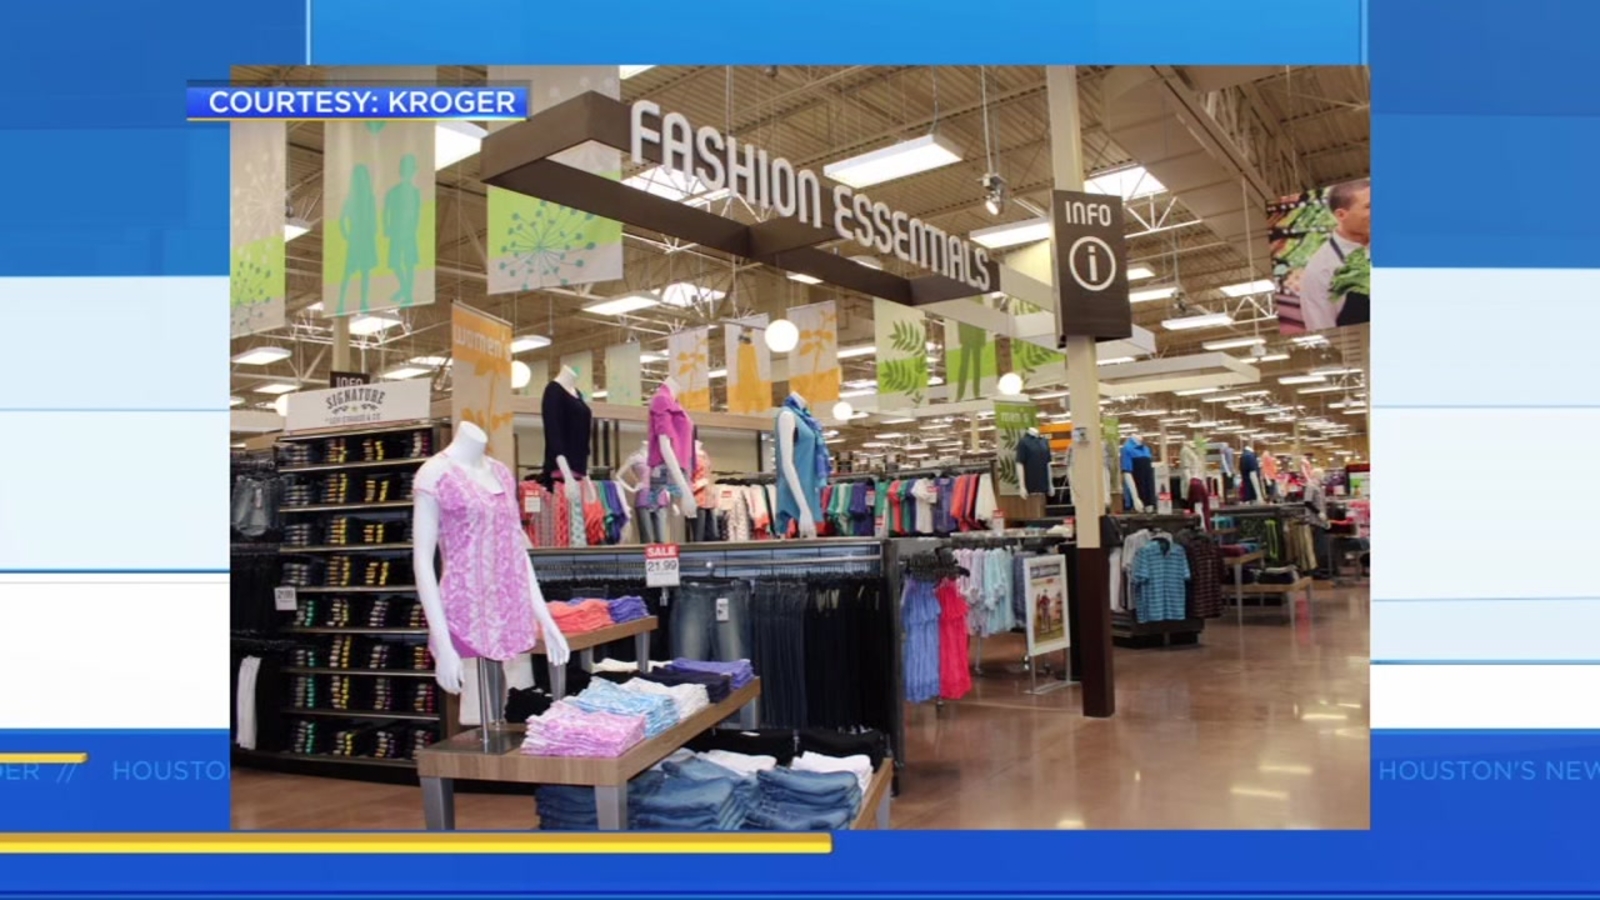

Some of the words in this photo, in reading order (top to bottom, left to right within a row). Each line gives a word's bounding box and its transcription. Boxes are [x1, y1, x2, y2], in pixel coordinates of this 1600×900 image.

[630, 100, 823, 229] FASHION
[833, 184, 991, 292] ESSENTIALS
[1065, 200, 1112, 227] INFO
[325, 387, 386, 411] SIGNATURE
[646, 545, 677, 557] SALE
[647, 559, 678, 572] 21.99
